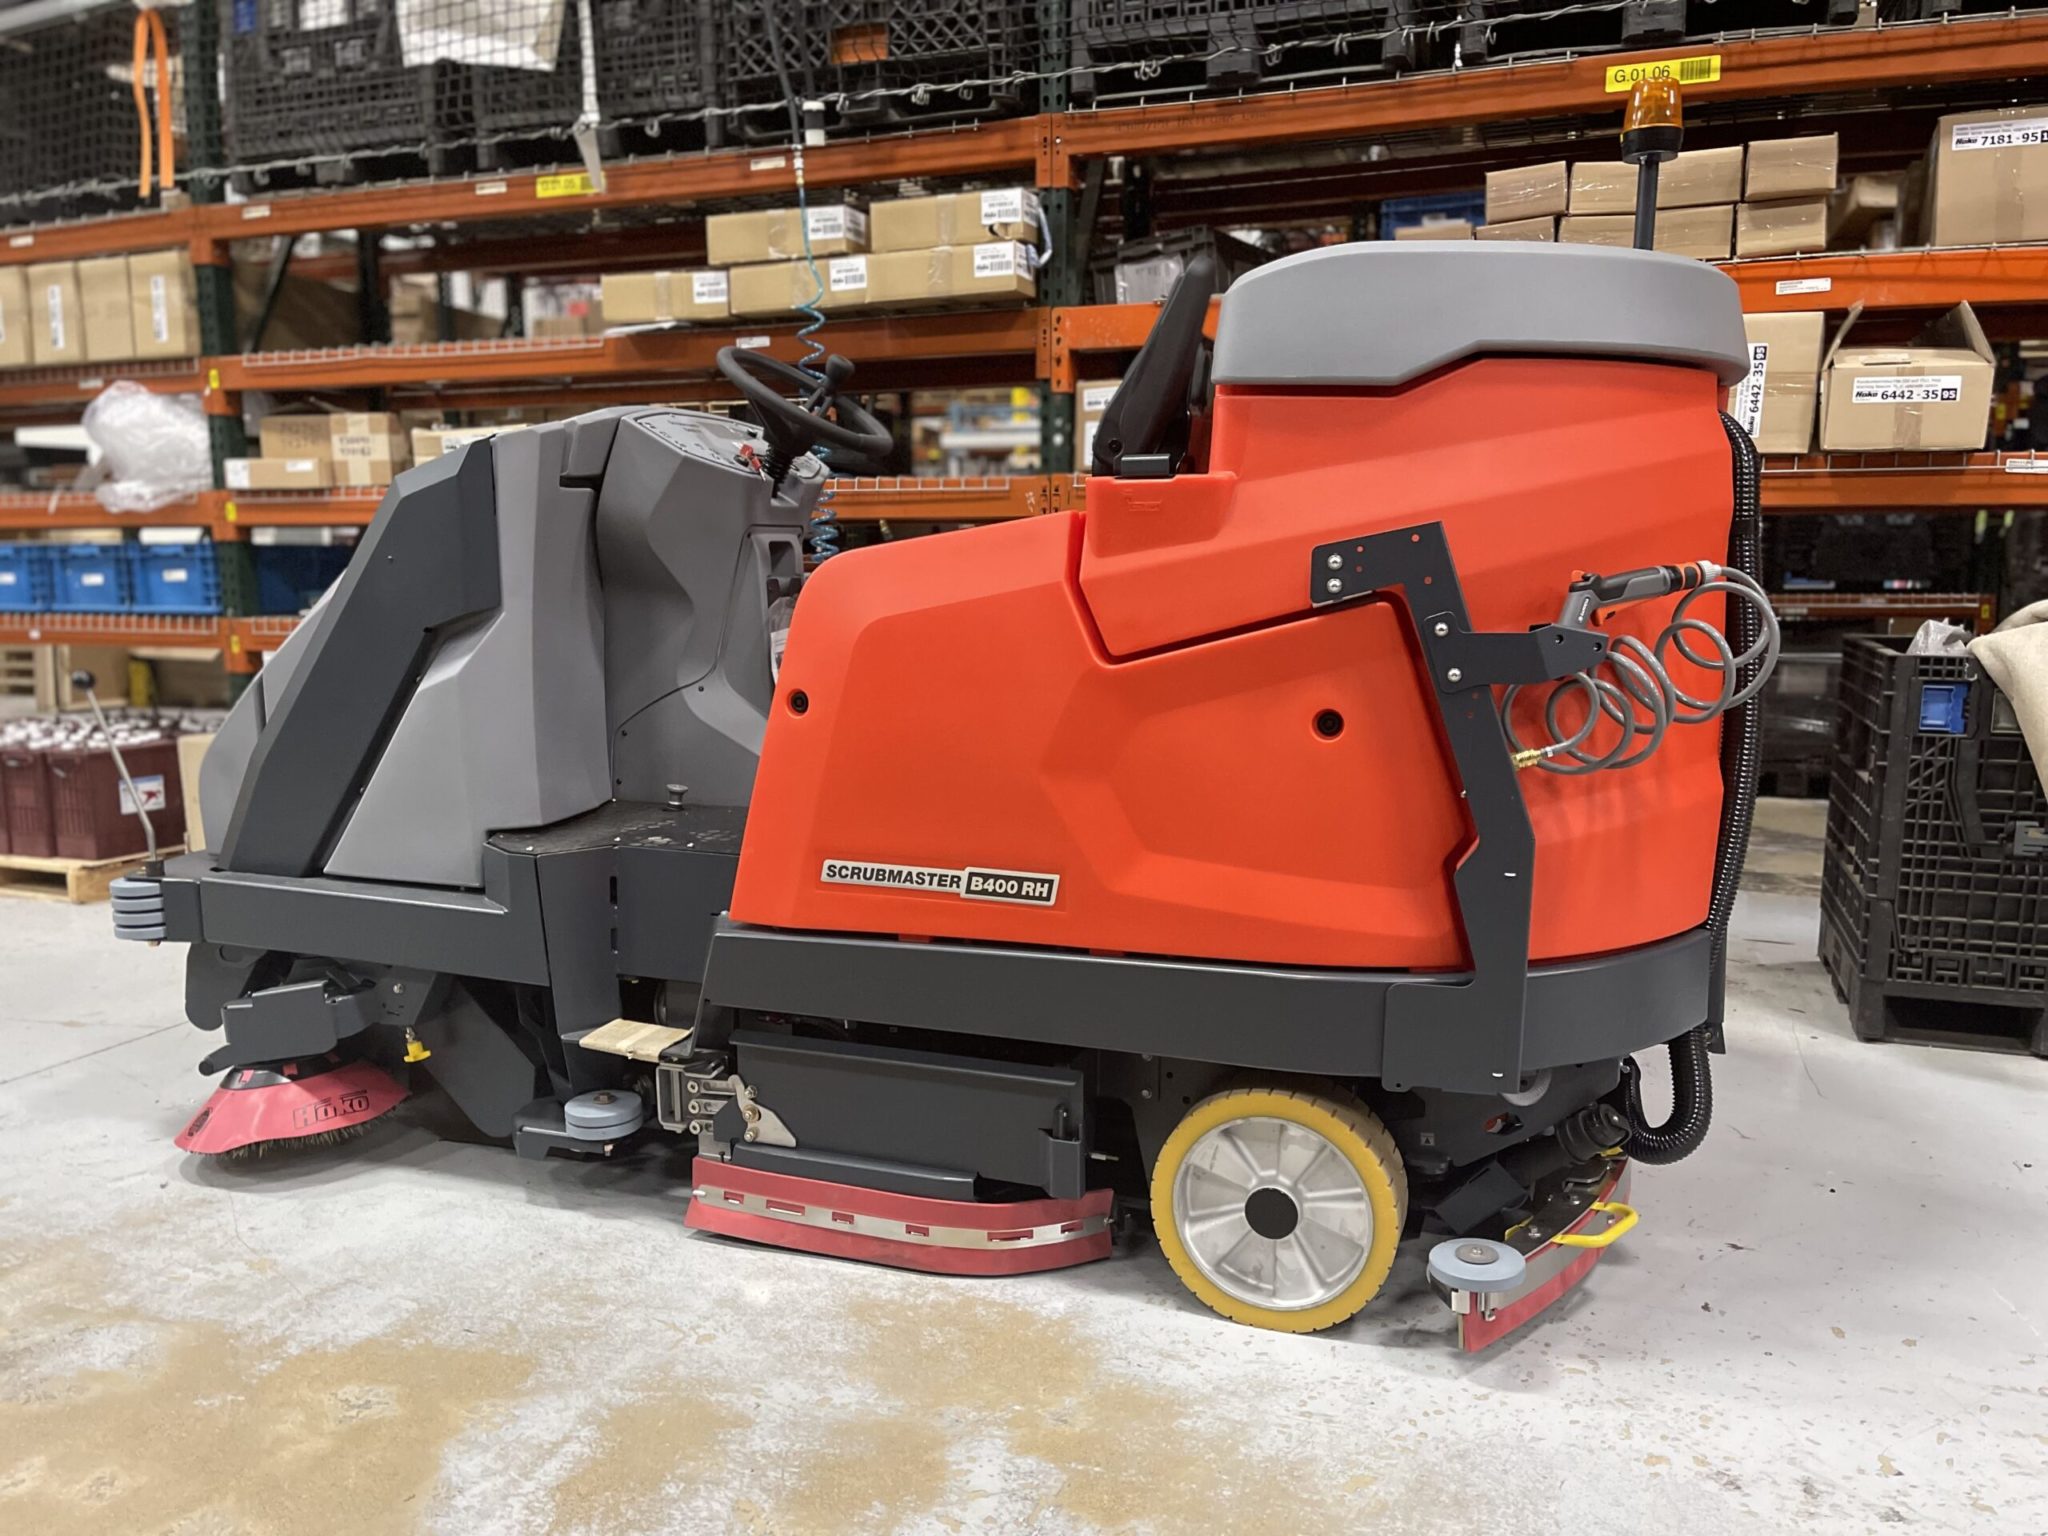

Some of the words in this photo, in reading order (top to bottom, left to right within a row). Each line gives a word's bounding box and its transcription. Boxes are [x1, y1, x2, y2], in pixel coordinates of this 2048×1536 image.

[1942, 390, 1956, 399] 95
[826, 864, 961, 890] SCRUBMASTER
[970, 877, 1018, 894] B400
[1021, 881, 1049, 897] RH
